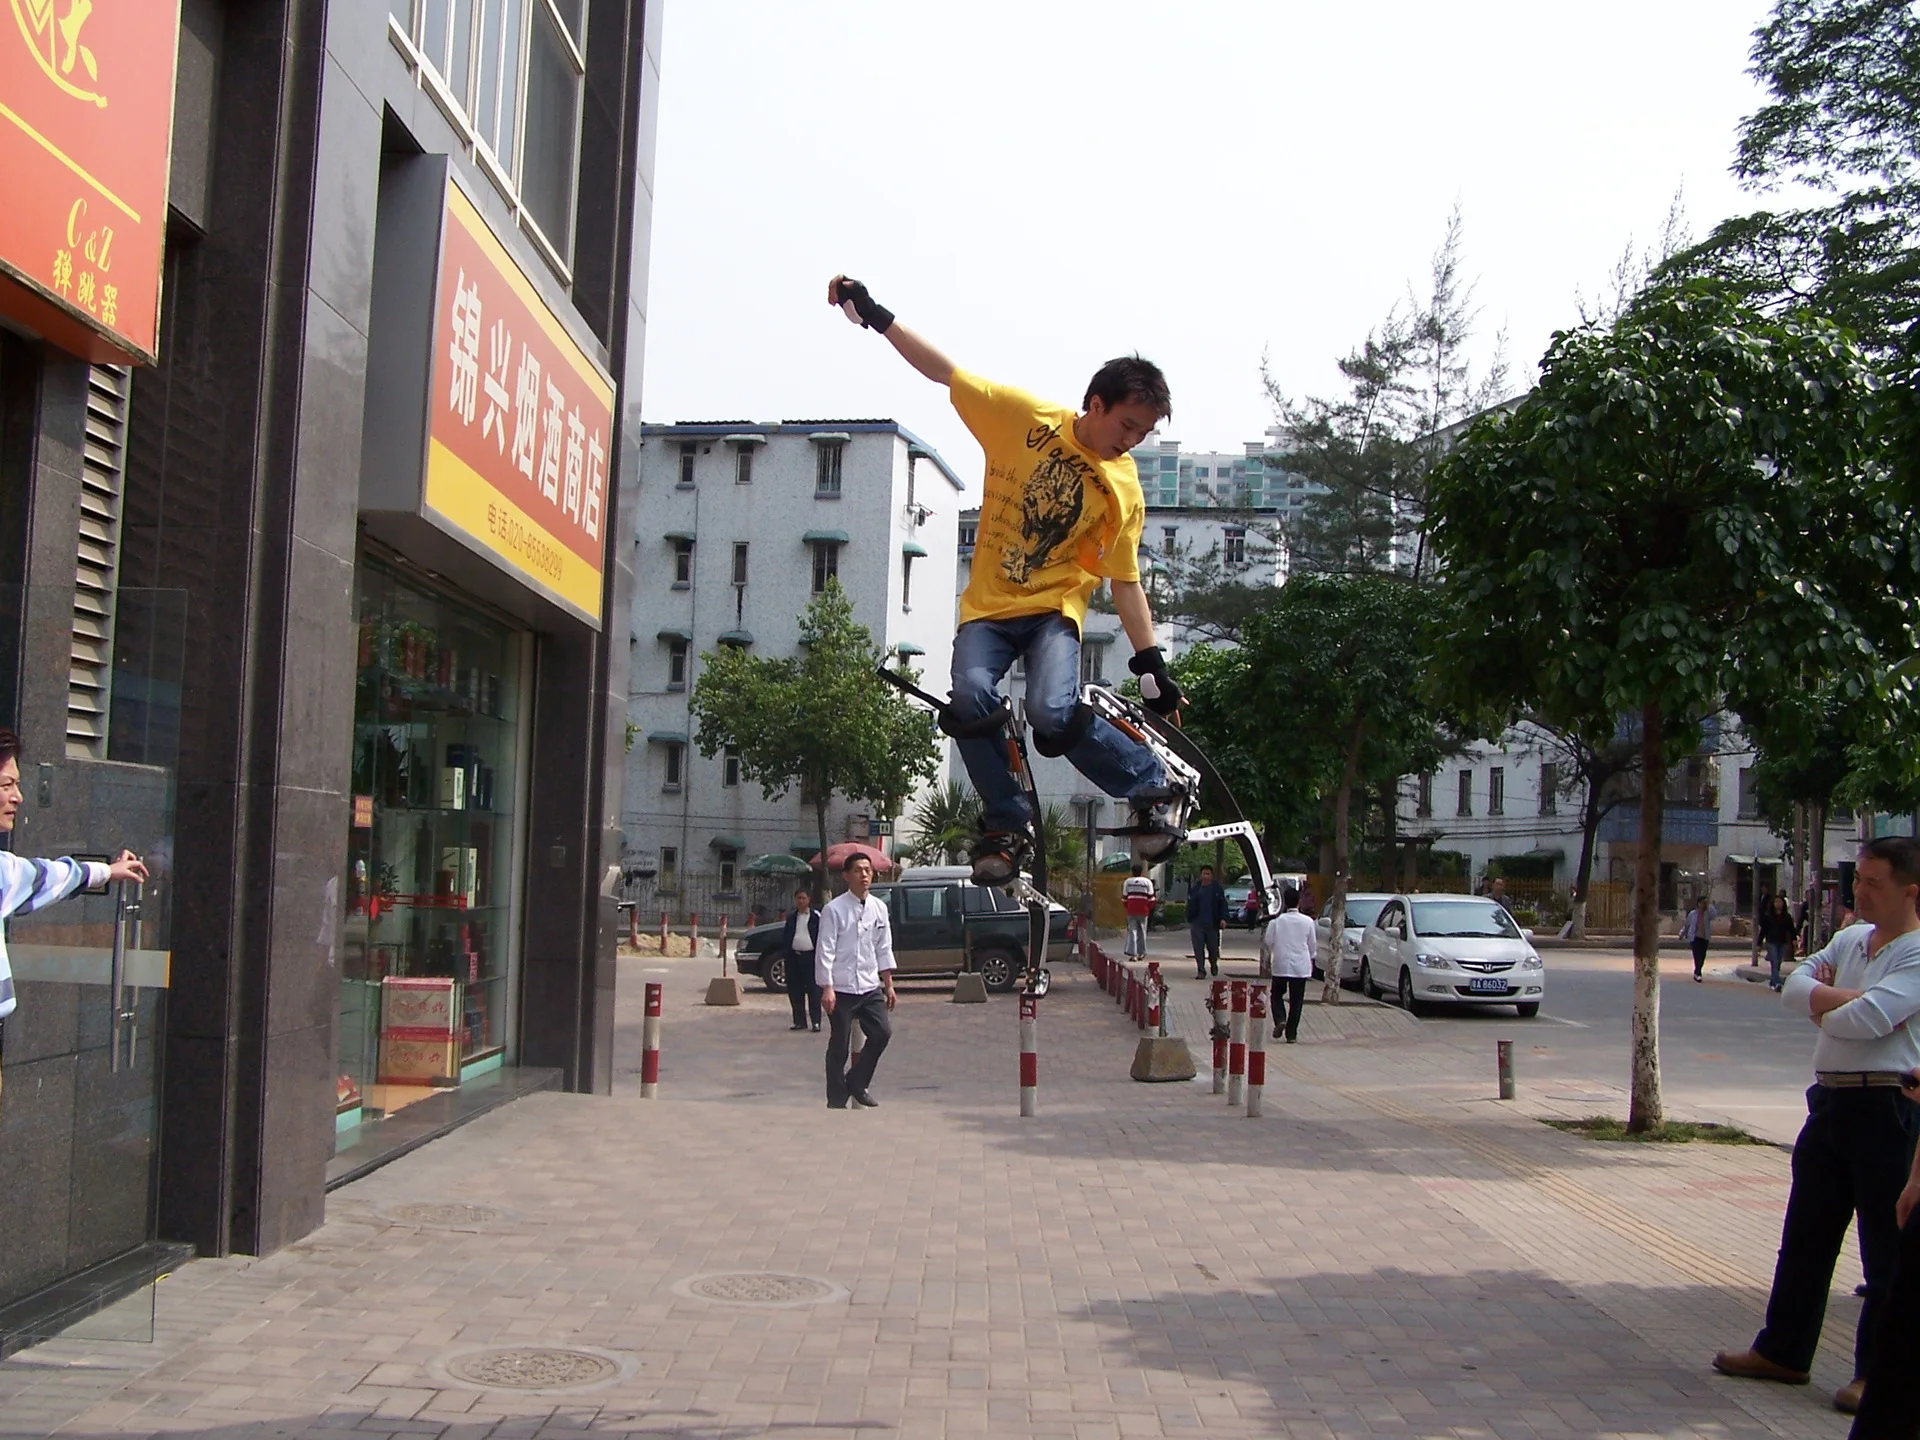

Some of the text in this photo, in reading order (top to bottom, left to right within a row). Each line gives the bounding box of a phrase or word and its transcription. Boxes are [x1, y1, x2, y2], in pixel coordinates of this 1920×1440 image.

[448, 265, 604, 544] 锦兴烟酒商店
